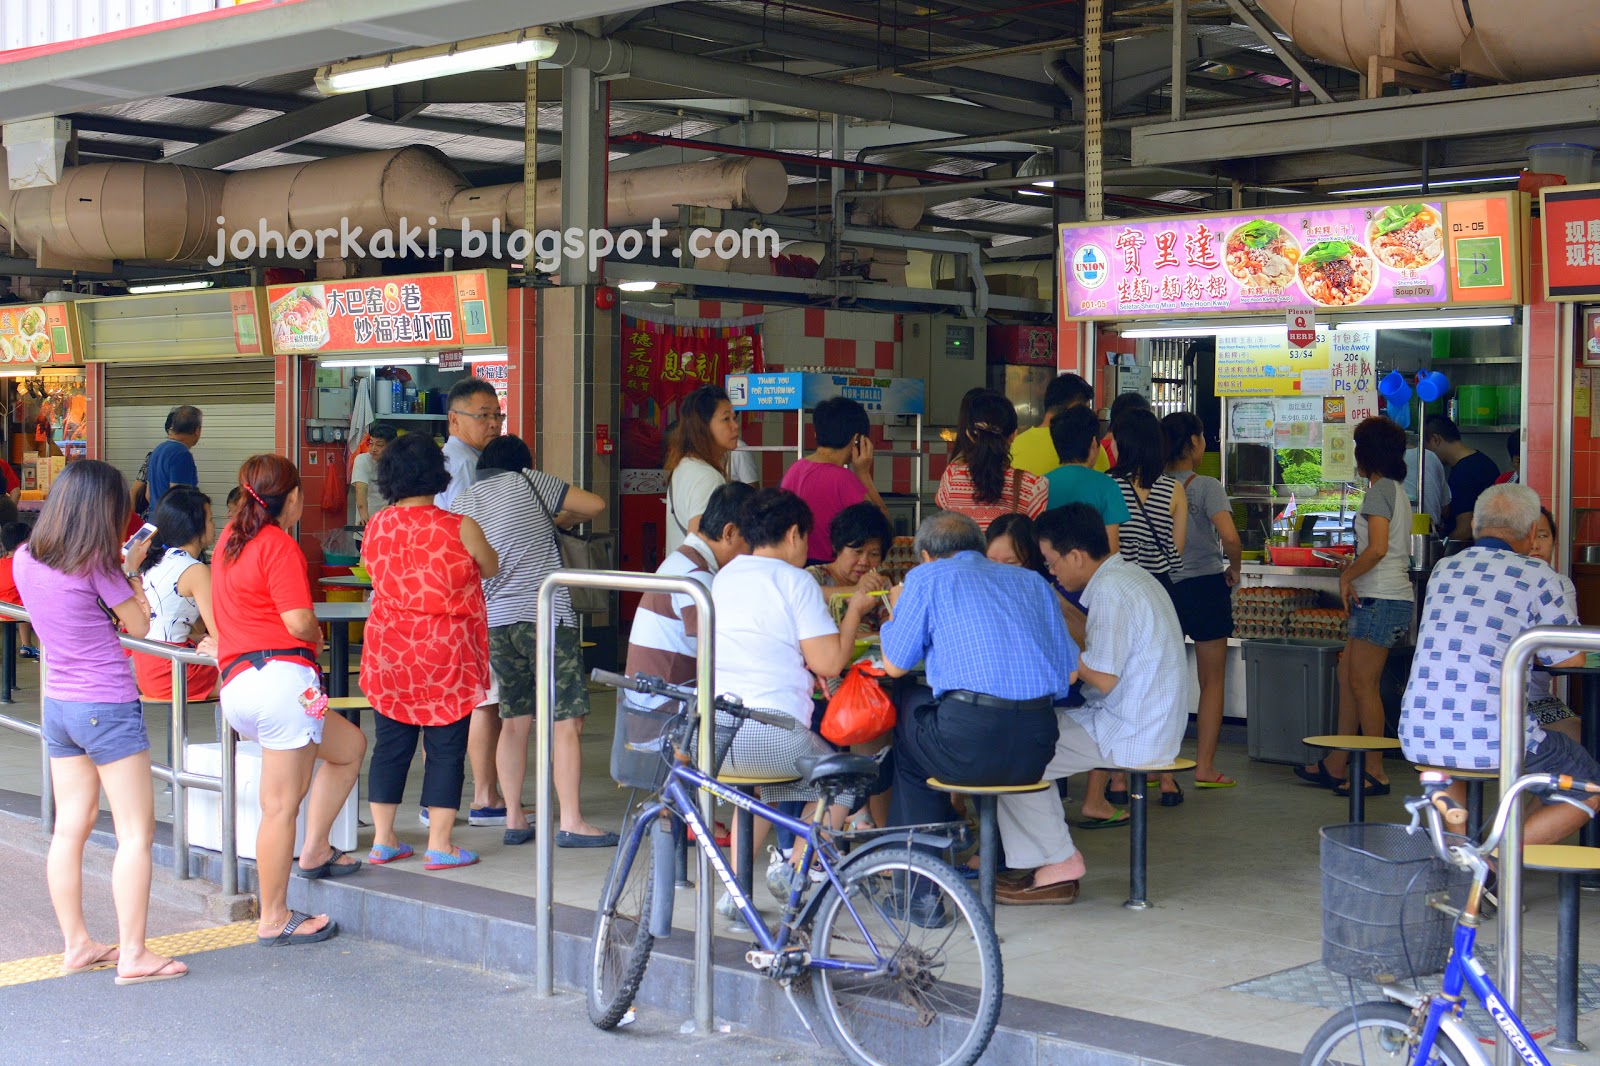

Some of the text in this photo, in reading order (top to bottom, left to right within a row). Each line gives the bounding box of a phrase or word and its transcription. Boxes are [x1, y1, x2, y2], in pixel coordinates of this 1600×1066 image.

[1366, 211, 1372, 220] 3
[1303, 219, 1308, 229] 2
[1216, 233, 1221, 242] 1
[1115, 224, 1221, 275] 實里達
[1075, 262, 1105, 272] UNION
[1471, 252, 1489, 275] B
[327, 282, 422, 317] 大巴窑8巷
[1081, 300, 1107, 309] #01-05
[1141, 302, 1160, 310] Sheng
[1294, 316, 1307, 328] Q
[354, 312, 453, 343] 炒福建虾面
[1289, 350, 1313, 359] $3/$4
[1332, 362, 1372, 377] 请排队
[777, 376, 790, 384] YOU
[1335, 379, 1351, 391] Pls
[751, 386, 796, 395] FOR RETURNING
[842, 388, 881, 400] NON-HALAL
[757, 396, 789, 405] YOUR TRAY
[1351, 408, 1371, 420] OPEN
